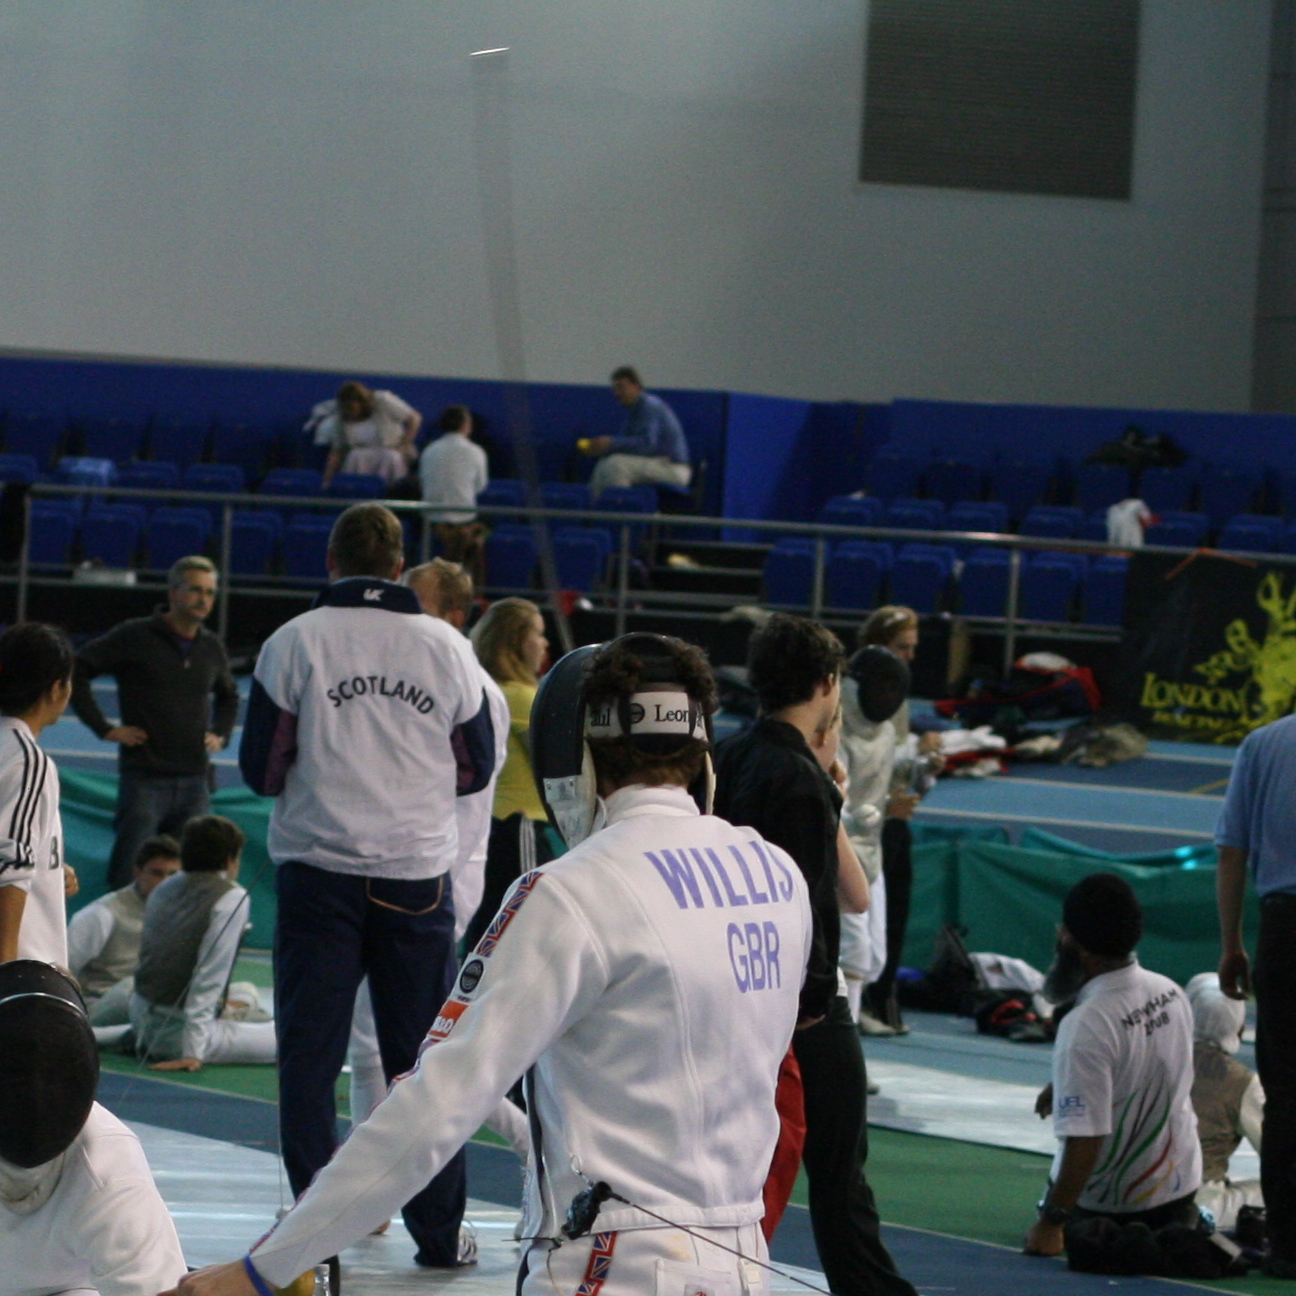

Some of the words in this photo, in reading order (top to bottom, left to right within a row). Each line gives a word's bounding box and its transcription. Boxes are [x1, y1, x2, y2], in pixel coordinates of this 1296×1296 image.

[326, 675, 434, 715] SCOTLAND
[589, 706, 611, 727] aul
[727, 921, 781, 993] GBR
